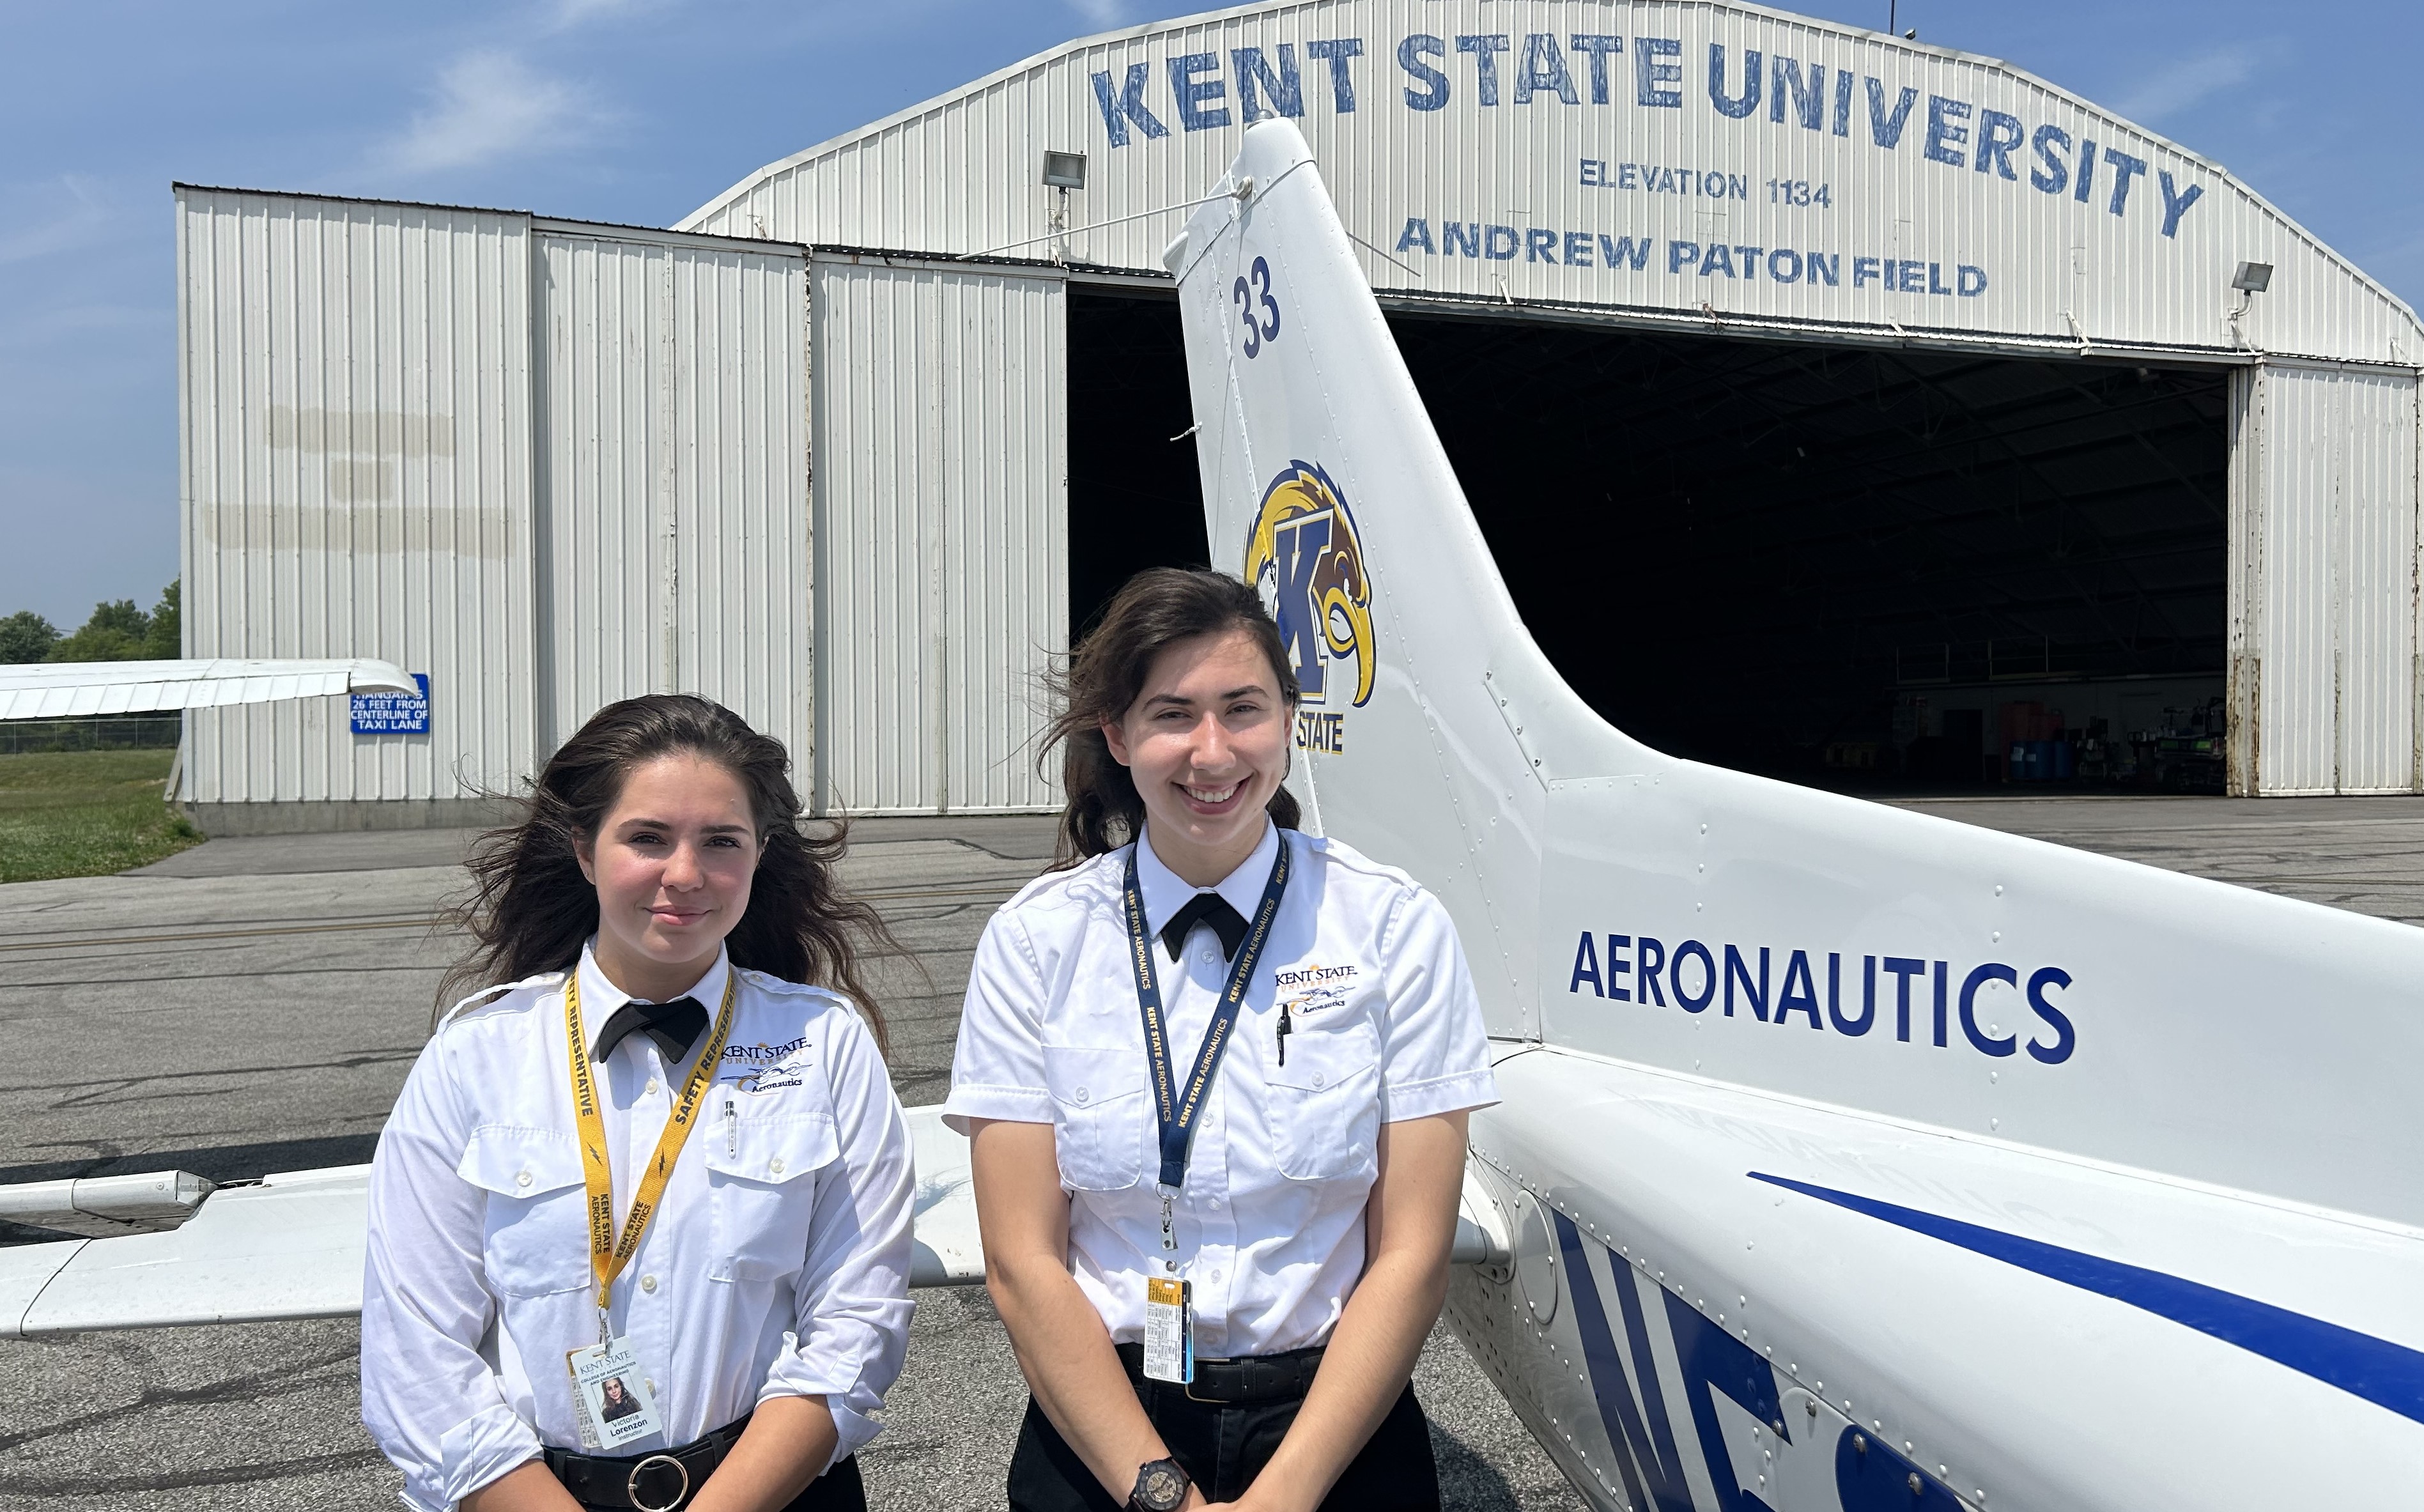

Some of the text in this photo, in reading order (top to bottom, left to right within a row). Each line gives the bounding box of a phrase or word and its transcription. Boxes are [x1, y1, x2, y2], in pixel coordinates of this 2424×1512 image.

[1092, 33, 2205, 240] KENT STATE UNIVERSITY
[1580, 158, 1832, 209] ELEVATION 1134
[1396, 217, 1988, 298] ANDREW PATON FIELD
[1233, 256, 1280, 360] 33
[1274, 505, 1334, 704] K
[351, 709, 428, 720] CENTERLINE OF
[353, 699, 426, 709] 26 FEET FROM
[357, 720, 422, 730] TAXI LANE
[1295, 710, 1343, 755] STATE
[1127, 888, 1137, 909] KENT
[1131, 909, 1142, 935] STATE
[1135, 935, 1151, 990] AERONAUTICS
[1228, 898, 1275, 1003] KENT STATE AERONAUTICS
[1275, 966, 1355, 987] KENT STATE
[1280, 976, 1349, 992] UNIVERSITY
[1570, 931, 2076, 1065] AERONAUTICS
[569, 1005, 594, 1117] REPRESENTATIVE
[721, 1037, 808, 1060] KENT STATE
[726, 1049, 803, 1065] UNIVERSITY
[1146, 1007, 1172, 1123] KENT STATE AERONAUTICS
[752, 1078, 803, 1092] Aeronautics
[1178, 1017, 1228, 1129] KENT STATE AERONAUTICS
[675, 1070, 706, 1125] SAFETY
[592, 1196, 602, 1254] AERONAUTICS
[601, 1194, 609, 1221] KENT
[615, 1200, 644, 1258] KENT STATE
[623, 1203, 651, 1260] AERONAUTICS
[580, 1359, 603, 1375] KENT
[605, 1350, 631, 1366] STATE
[610, 1419, 648, 1437] Lorenzon
[612, 1414, 640, 1428] Victoria
